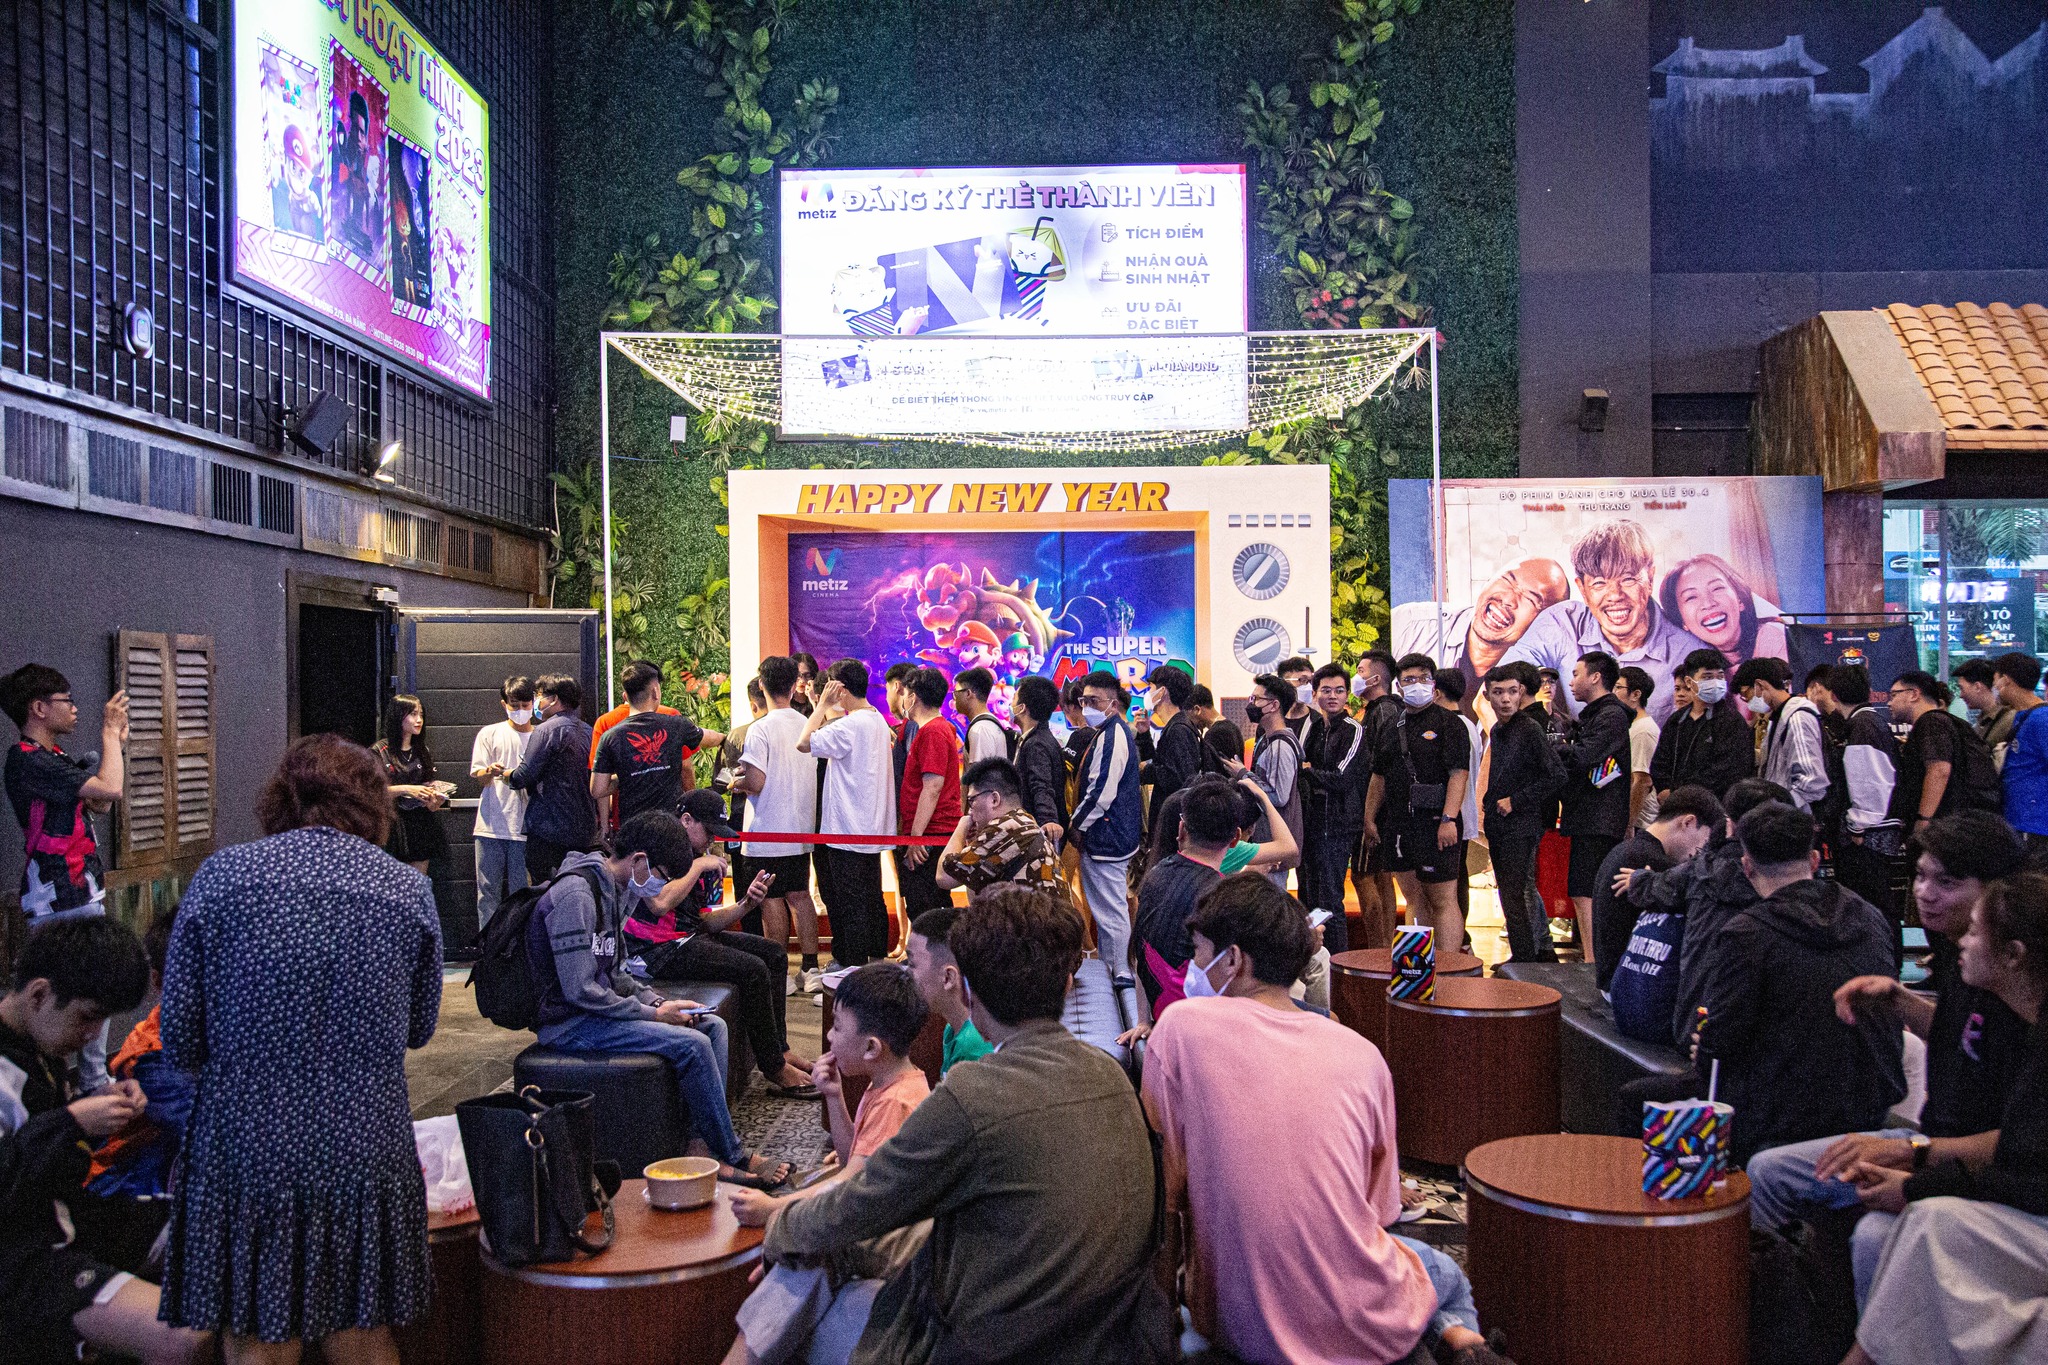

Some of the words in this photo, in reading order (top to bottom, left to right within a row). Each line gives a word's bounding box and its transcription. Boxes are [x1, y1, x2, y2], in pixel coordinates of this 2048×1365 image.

[419, 52, 466, 132] HÌNH
[435, 113, 486, 197] 2023
[843, 184, 928, 212] ĐĂNG
[975, 180, 1036, 209] THẺ
[1036, 180, 1142, 209] THÀNH
[798, 208, 837, 219] metiz
[1125, 225, 1161, 239] TÍCH
[1165, 222, 1204, 239] ĐIỂM
[1125, 253, 1171, 270] NHẬN
[1174, 252, 1208, 267] QUẢ
[1125, 273, 1162, 284] SINH
[1167, 270, 1210, 287] NHẬT
[1126, 302, 1150, 313] ƯU
[1155, 298, 1182, 313] ĐÃI
[1164, 316, 1199, 334] BIỆT
[1105, 394, 1130, 402] TRUY
[797, 483, 943, 513] HAPPY
[948, 482, 1052, 512] NEW
[1062, 482, 1171, 512] YEAR
[1521, 490, 1552, 499] PHIM
[1599, 488, 1625, 498] CHO
[1681, 487, 1709, 497] 30.4
[1579, 503, 1598, 511] THU
[1599, 503, 1631, 511] TRANG
[802, 578, 849, 591] metiz
[1991, 606, 2012, 620] TÔ
[1064, 643, 1089, 655] THE
[1092, 636, 1167, 656] SUPER
[1641, 961, 1663, 976] OH
